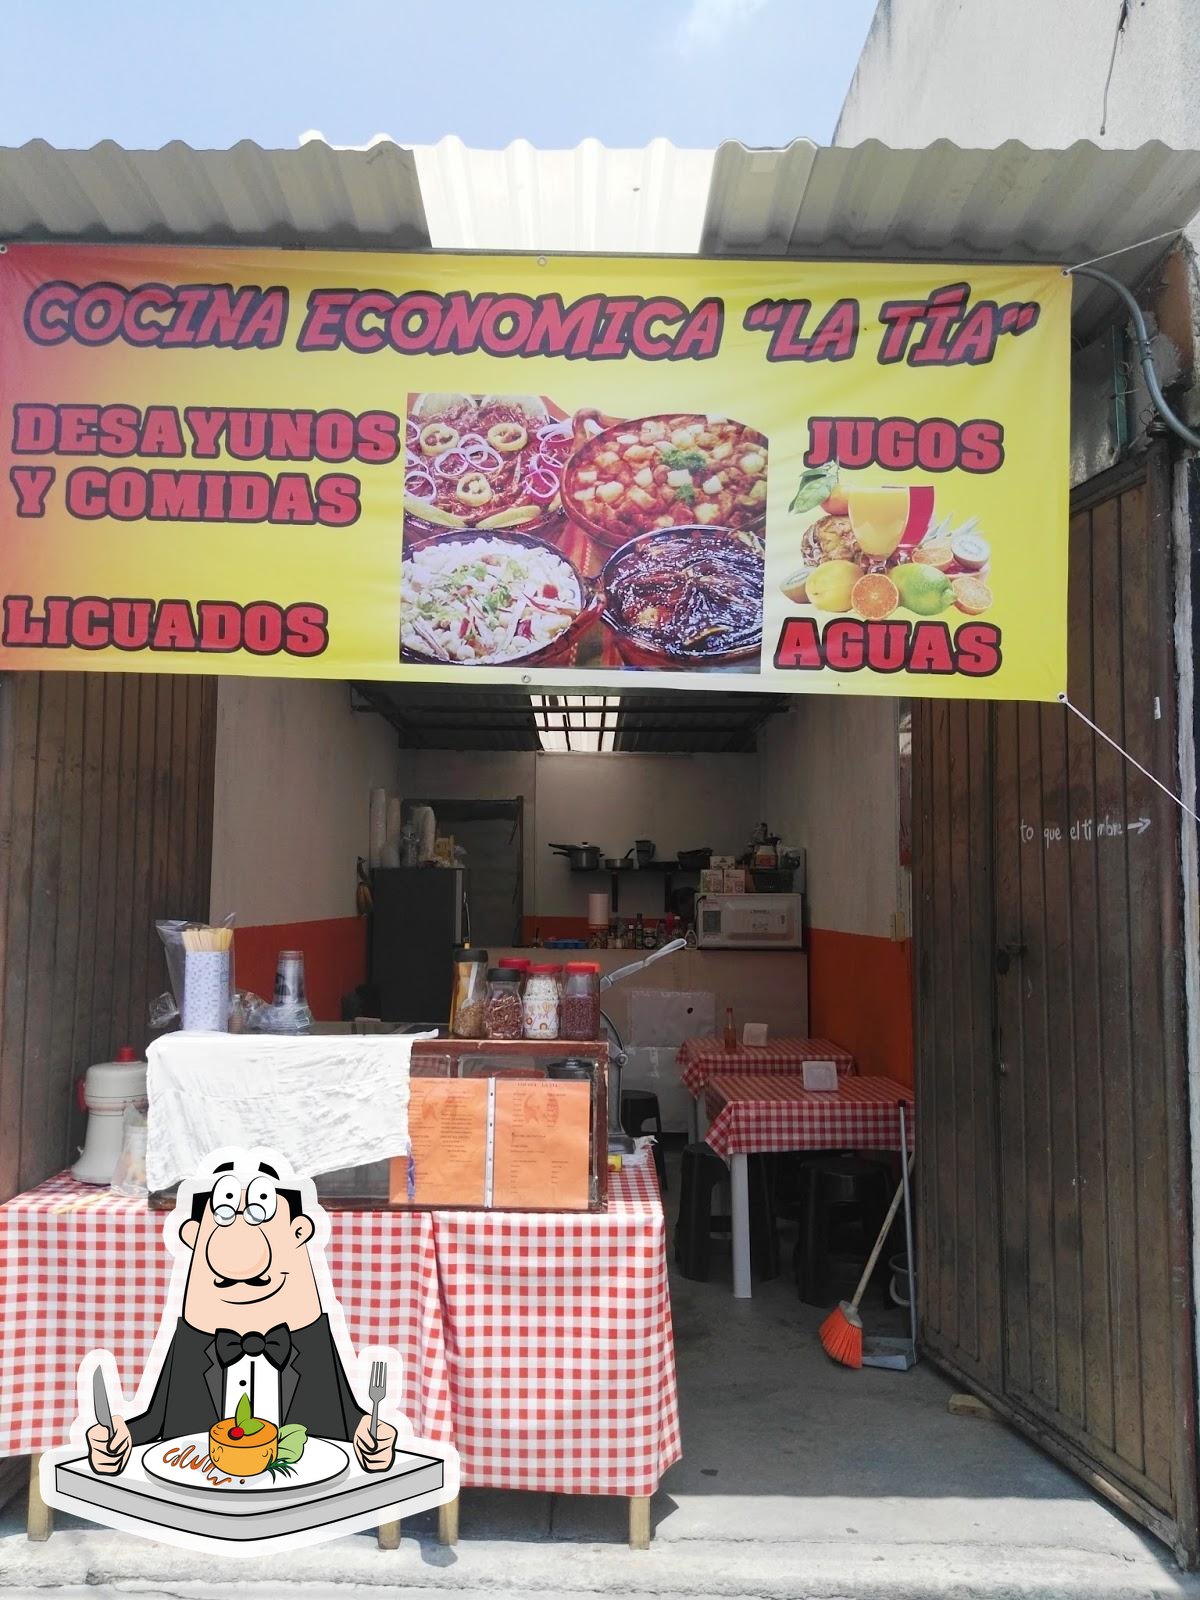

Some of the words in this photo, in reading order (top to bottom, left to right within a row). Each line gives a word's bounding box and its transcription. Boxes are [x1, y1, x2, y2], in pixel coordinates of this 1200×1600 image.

[24, 280, 290, 350] COCINA
[297, 286, 724, 360] ECONOMICA
[13, 403, 400, 464] DESAYUNOS
[805, 416, 1004, 473] JUGOS
[10, 465, 55, 517] Y
[66, 467, 361, 528] COMIDAS
[2, 594, 328, 657] LICUADOS
[774, 617, 1003, 676] AGUAS
